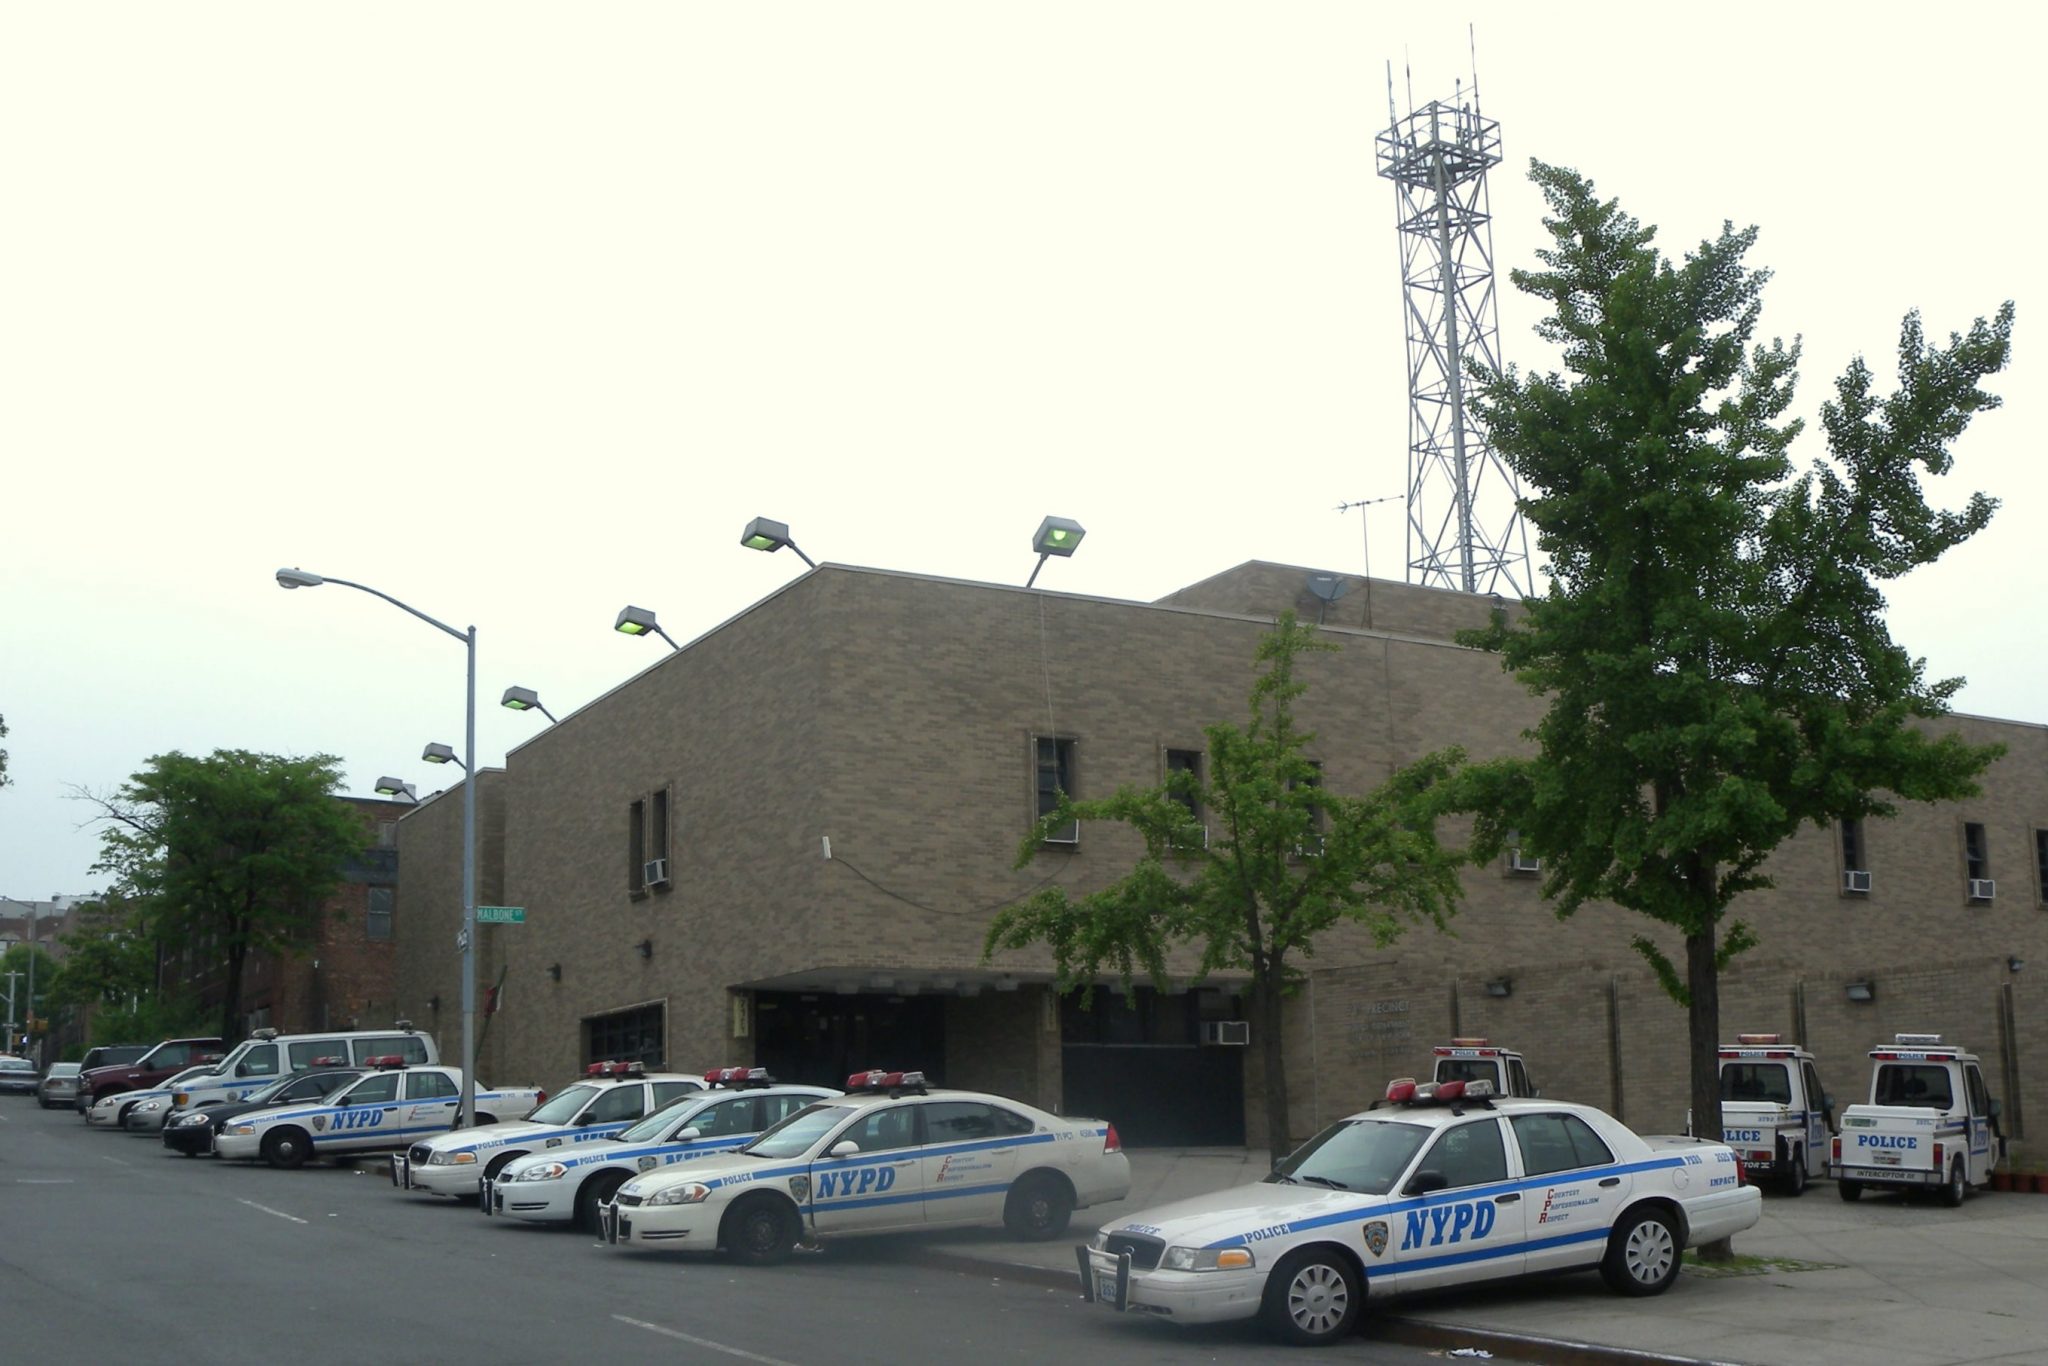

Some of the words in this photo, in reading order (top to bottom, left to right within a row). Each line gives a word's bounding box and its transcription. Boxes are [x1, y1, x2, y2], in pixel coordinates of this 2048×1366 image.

[330, 1109, 383, 1131] NYPD
[1722, 1130, 1760, 1141] LICE
[1858, 1135, 1917, 1149] POLICE
[477, 1139, 504, 1150] POLICE
[579, 1154, 605, 1167] POLICE
[722, 1172, 752, 1186] POLICE
[1710, 1176, 1735, 1187] IMPACT
[1856, 1170, 1905, 1179] INTERCEPTOR
[816, 1167, 896, 1199] NYPD
[1544, 1197, 1599, 1211] PROFESSIONALISM
[1125, 1223, 1161, 1234] POLICE
[1401, 1200, 1496, 1251] NYPD
[1245, 1223, 1289, 1243] POLICE
